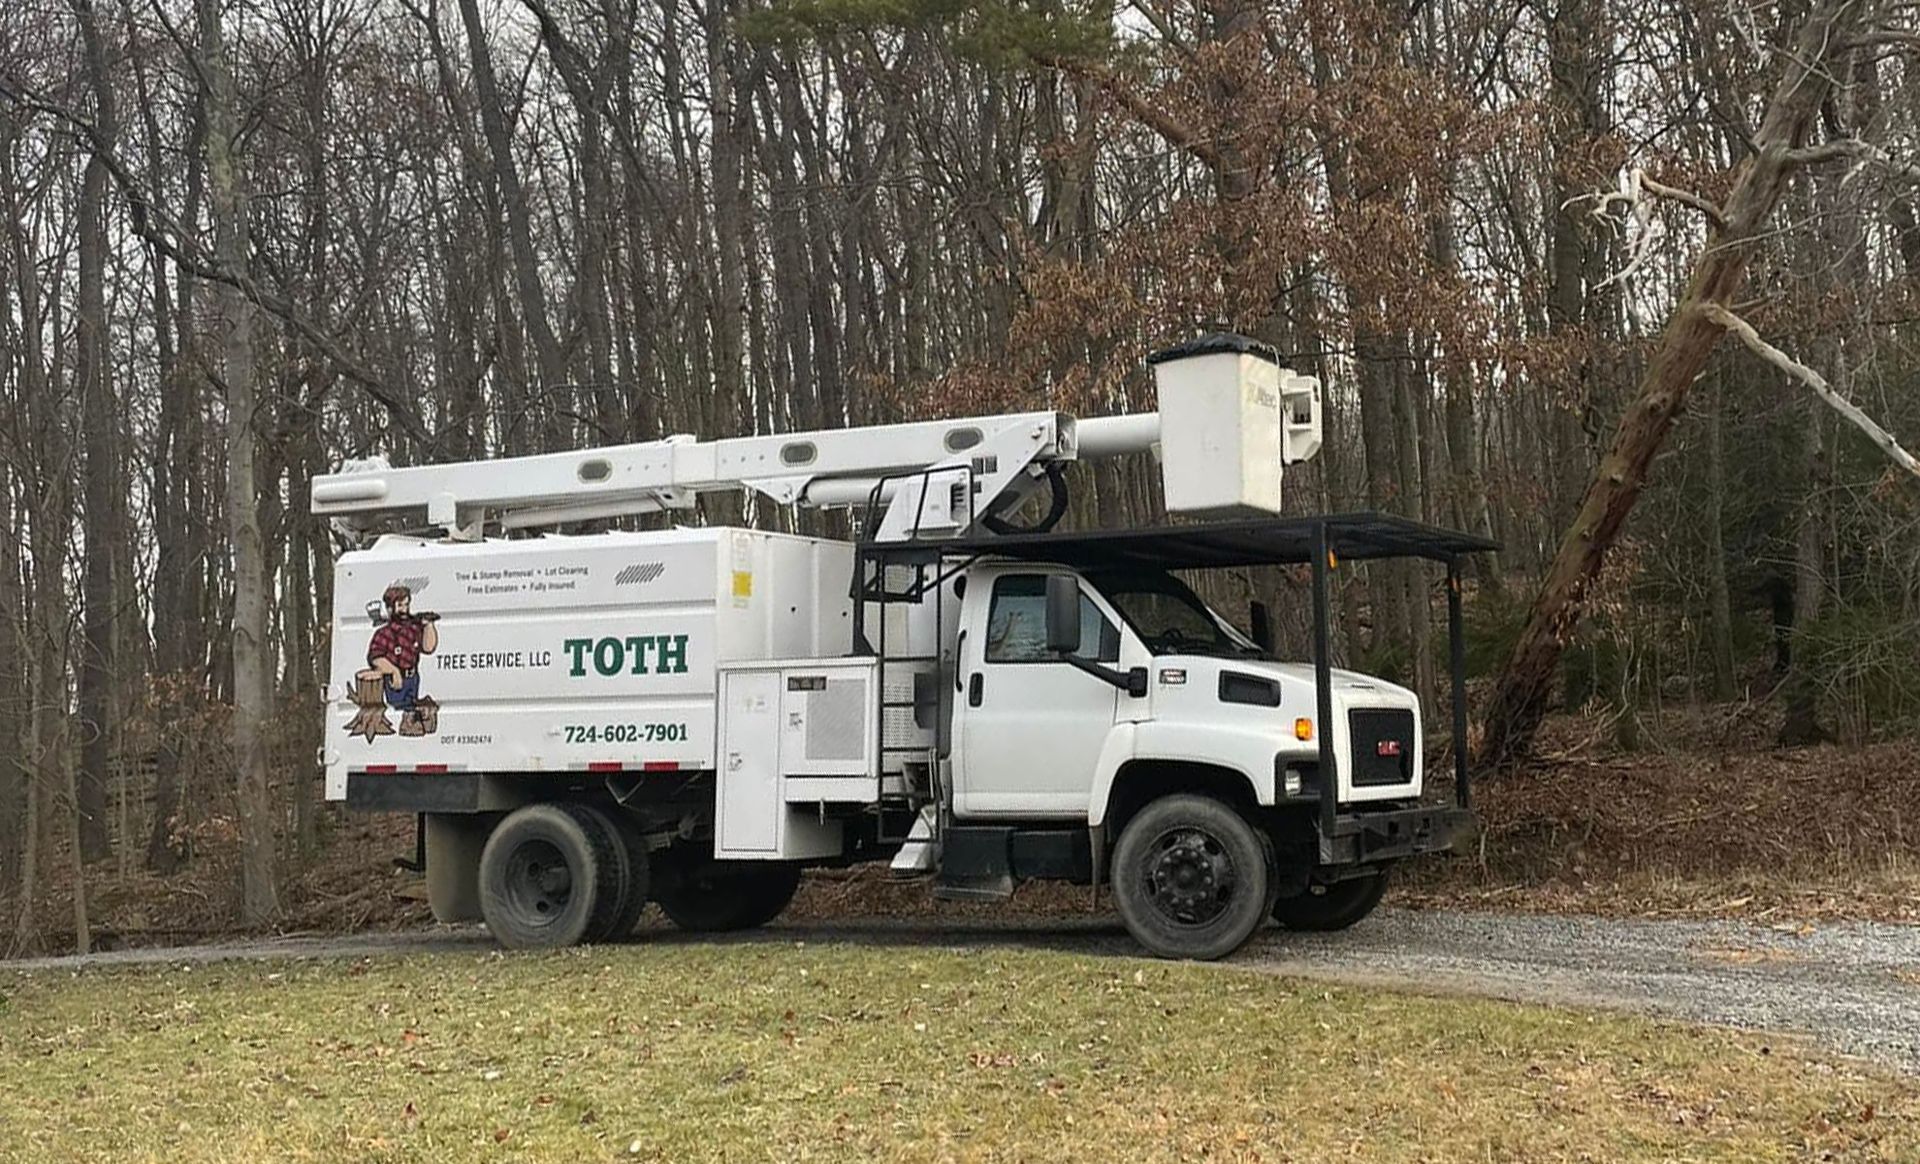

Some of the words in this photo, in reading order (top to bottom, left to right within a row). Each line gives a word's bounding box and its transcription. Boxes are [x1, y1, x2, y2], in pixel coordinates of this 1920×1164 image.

[456, 572, 470, 580] Tree
[472, 571, 478, 580] &
[480, 570, 501, 580] Stump
[503, 568, 533, 578] Removal
[545, 567, 557, 576] Lot
[558, 565, 588, 576] Clearing
[467, 585, 483, 594] Free
[485, 584, 518, 594] Estimates
[530, 581, 546, 592] Fully
[548, 580, 575, 590] Insured
[436, 654, 466, 669] TREE
[470, 652, 525, 669] SERVICE,
[529, 651, 551, 667] LLC
[564, 635, 688, 677] TOTH
[440, 735, 455, 744] DOT
[565, 723, 687, 743] 724-602-7901
